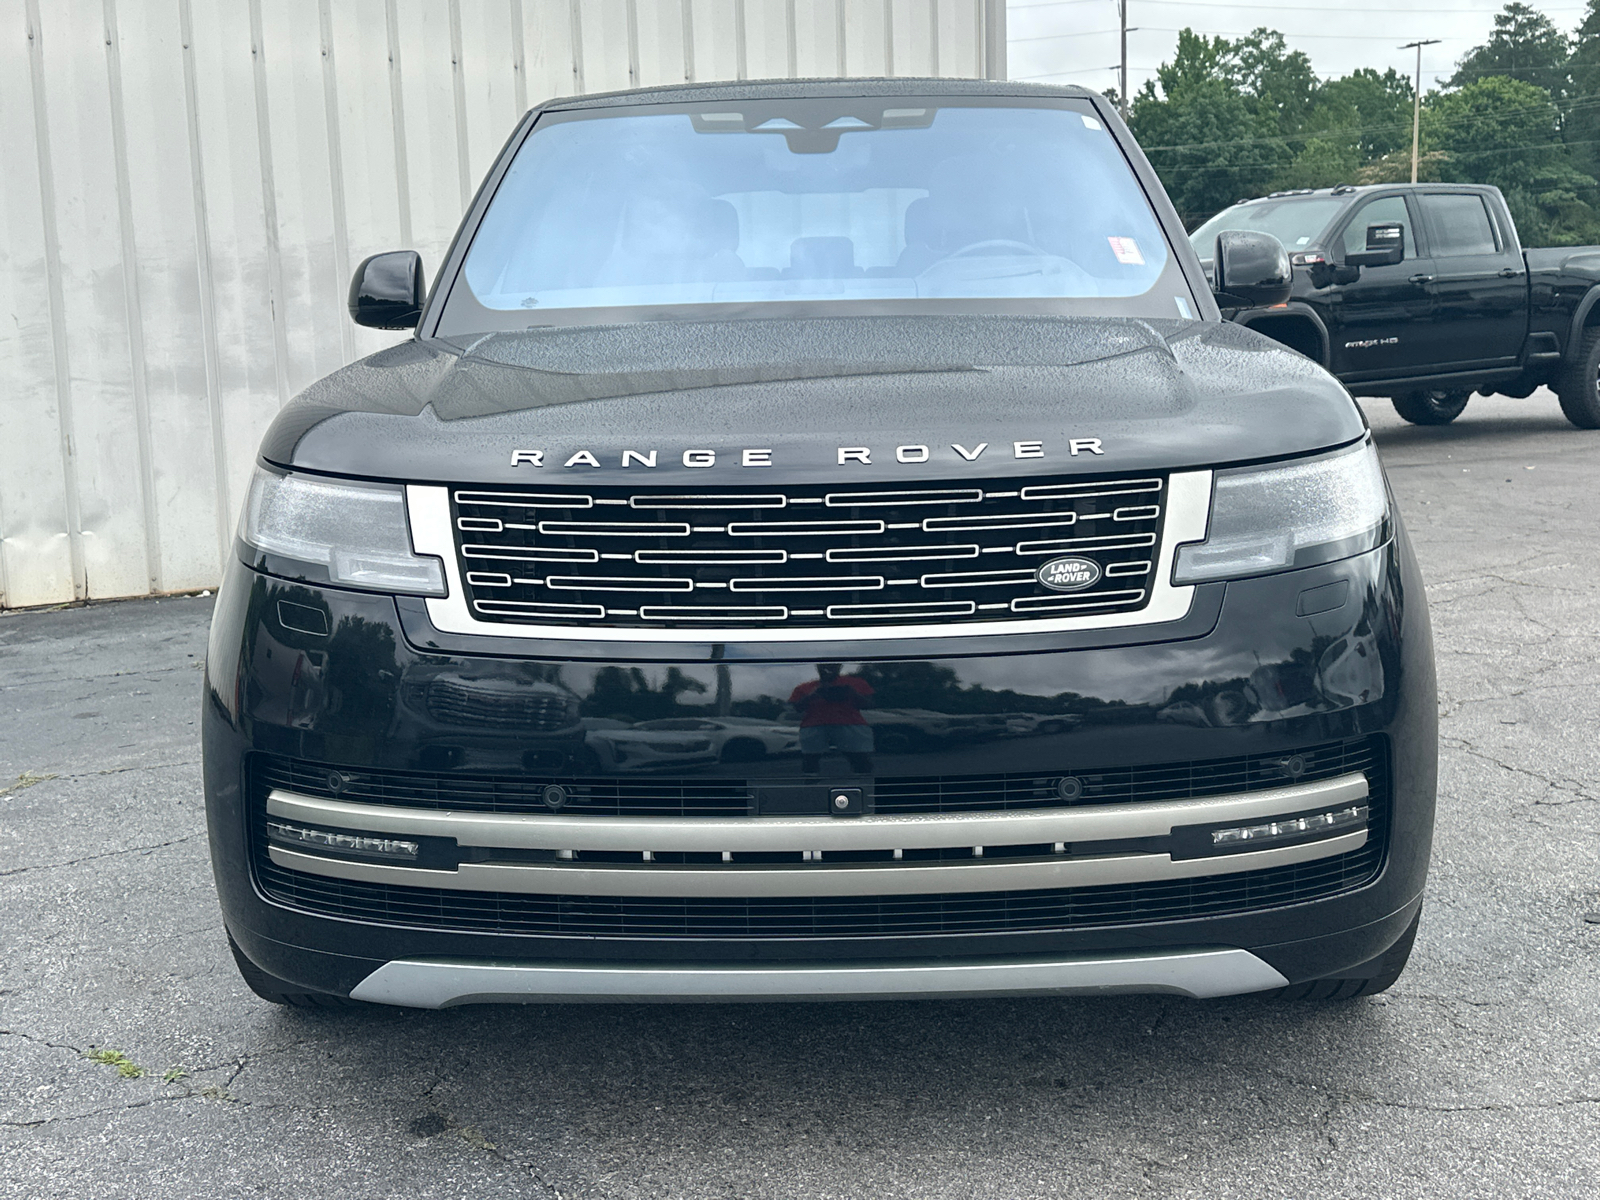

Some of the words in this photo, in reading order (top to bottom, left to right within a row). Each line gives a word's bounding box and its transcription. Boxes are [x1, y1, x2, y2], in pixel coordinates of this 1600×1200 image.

[510, 448, 773, 468] RANGE
[837, 437, 1105, 466] ROVER
[1051, 563, 1080, 574] LAND
[1054, 571, 1091, 583] ROVER
